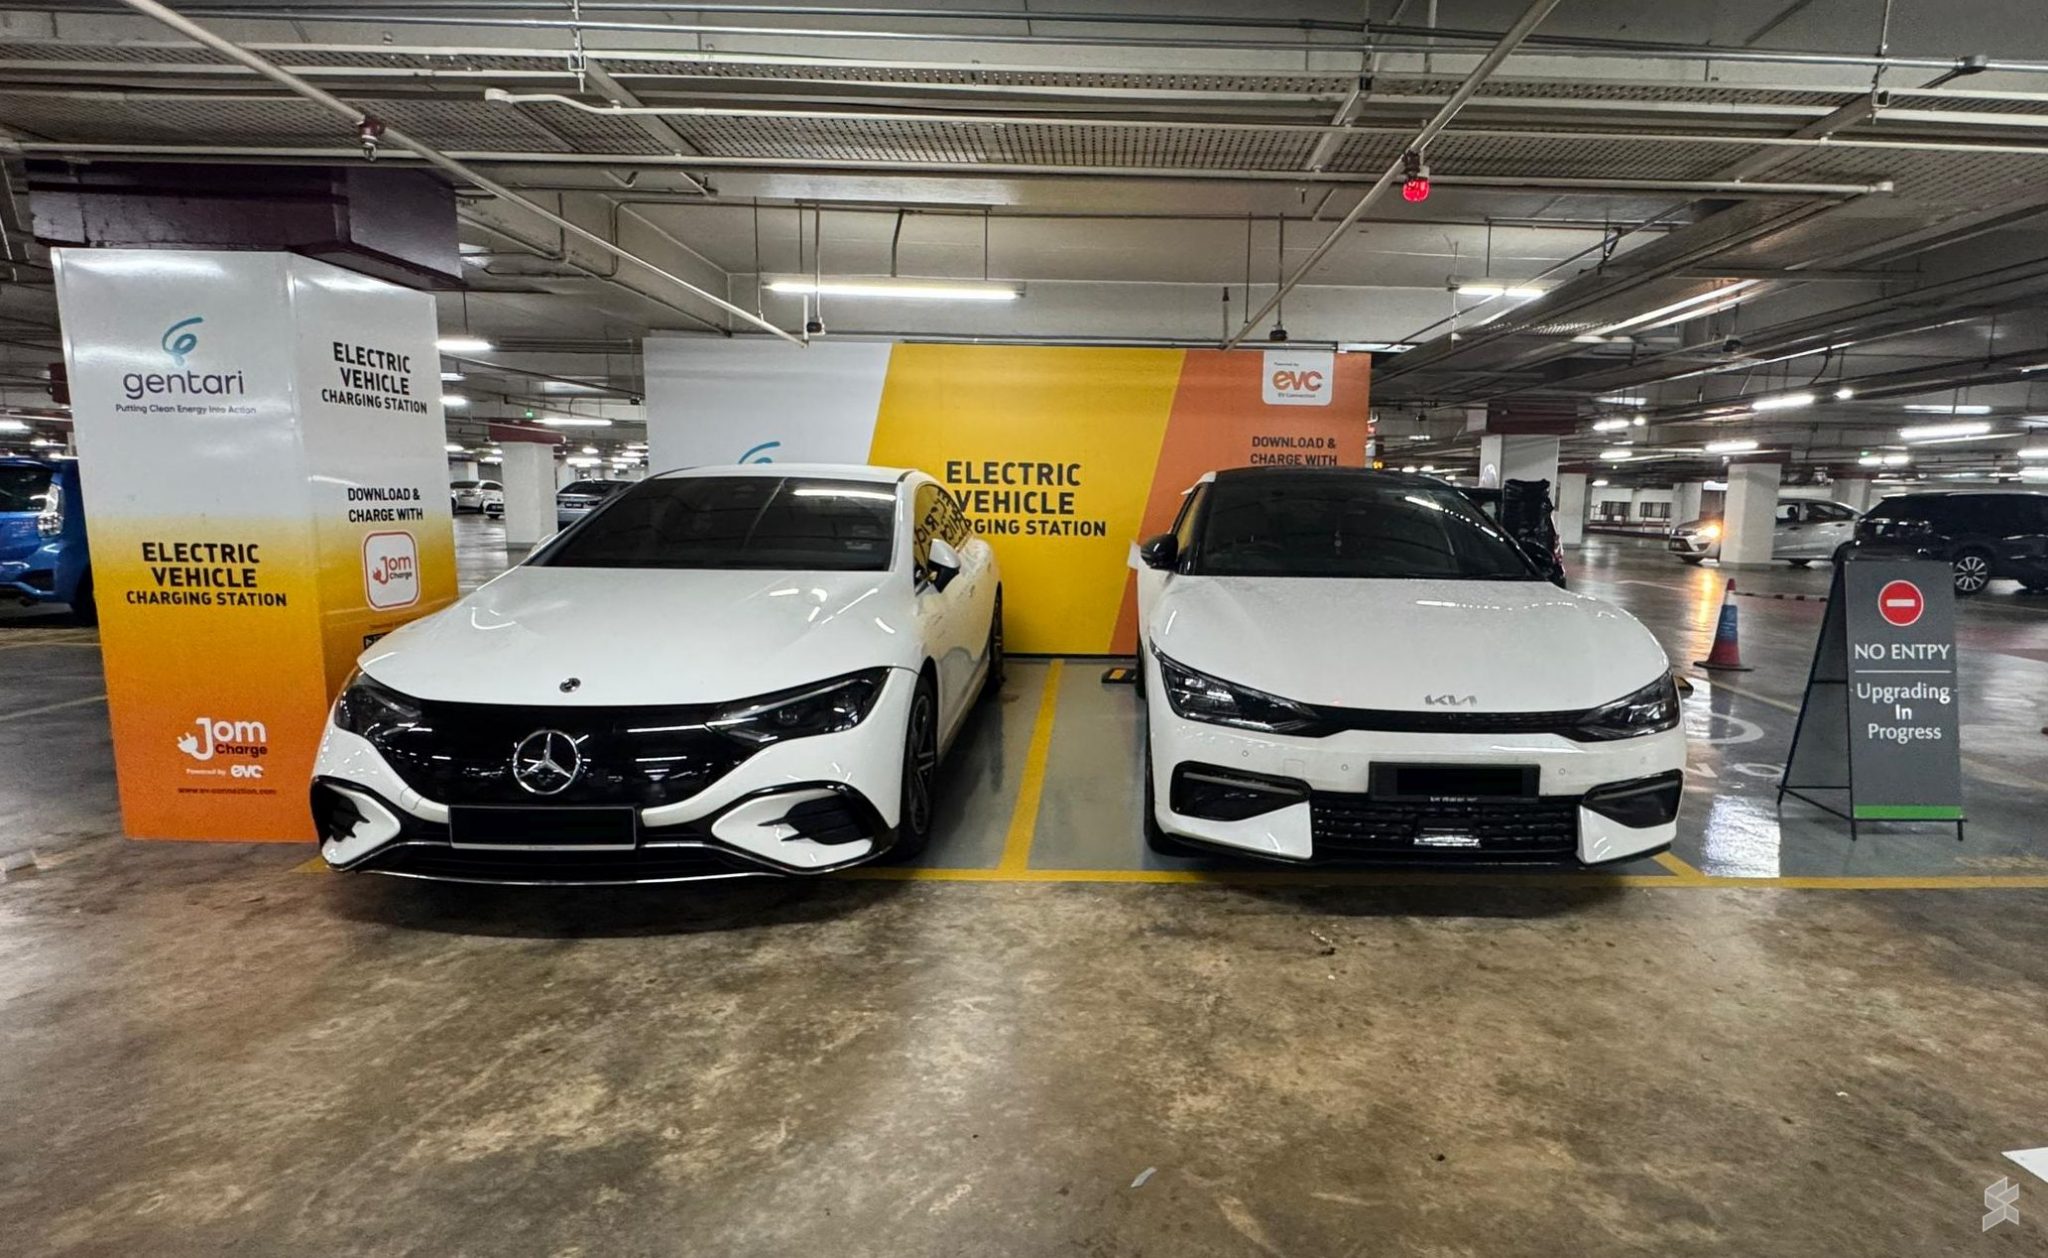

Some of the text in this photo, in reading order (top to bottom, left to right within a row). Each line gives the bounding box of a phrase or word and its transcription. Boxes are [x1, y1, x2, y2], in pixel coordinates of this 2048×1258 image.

[333, 341, 411, 374] ELECTRIC
[122, 370, 244, 400] gentari
[340, 366, 410, 396] VEHICLE
[1271, 370, 1323, 391] evc
[115, 403, 148, 414] Putting
[149, 404, 175, 413] Clean
[177, 404, 207, 415] Energy
[228, 405, 257, 414] Action
[321, 388, 428, 415] CHARGING STATION
[1251, 436, 1337, 449] DOWNLOAD &
[1250, 453, 1338, 466] CHARGE WITH
[946, 460, 1081, 486] ELECTRIC
[347, 487, 421, 501] DOWNLOAD &
[954, 490, 1075, 515] VEHICLE
[348, 508, 424, 523] CHARGE WITH
[1025, 520, 1106, 537] STATION
[142, 542, 260, 564] ELECTRIC
[151, 567, 257, 588] VEHICLE
[389, 571, 412, 581] Charge
[126, 590, 287, 607] CHARGING STATION
[1854, 643, 1951, 660] NO ENTPY
[1856, 681, 1951, 705] Upgrading
[1895, 704, 1913, 720] In
[1867, 723, 1942, 744] Progress
[215, 744, 268, 758] Charge
[230, 764, 264, 778] evc
